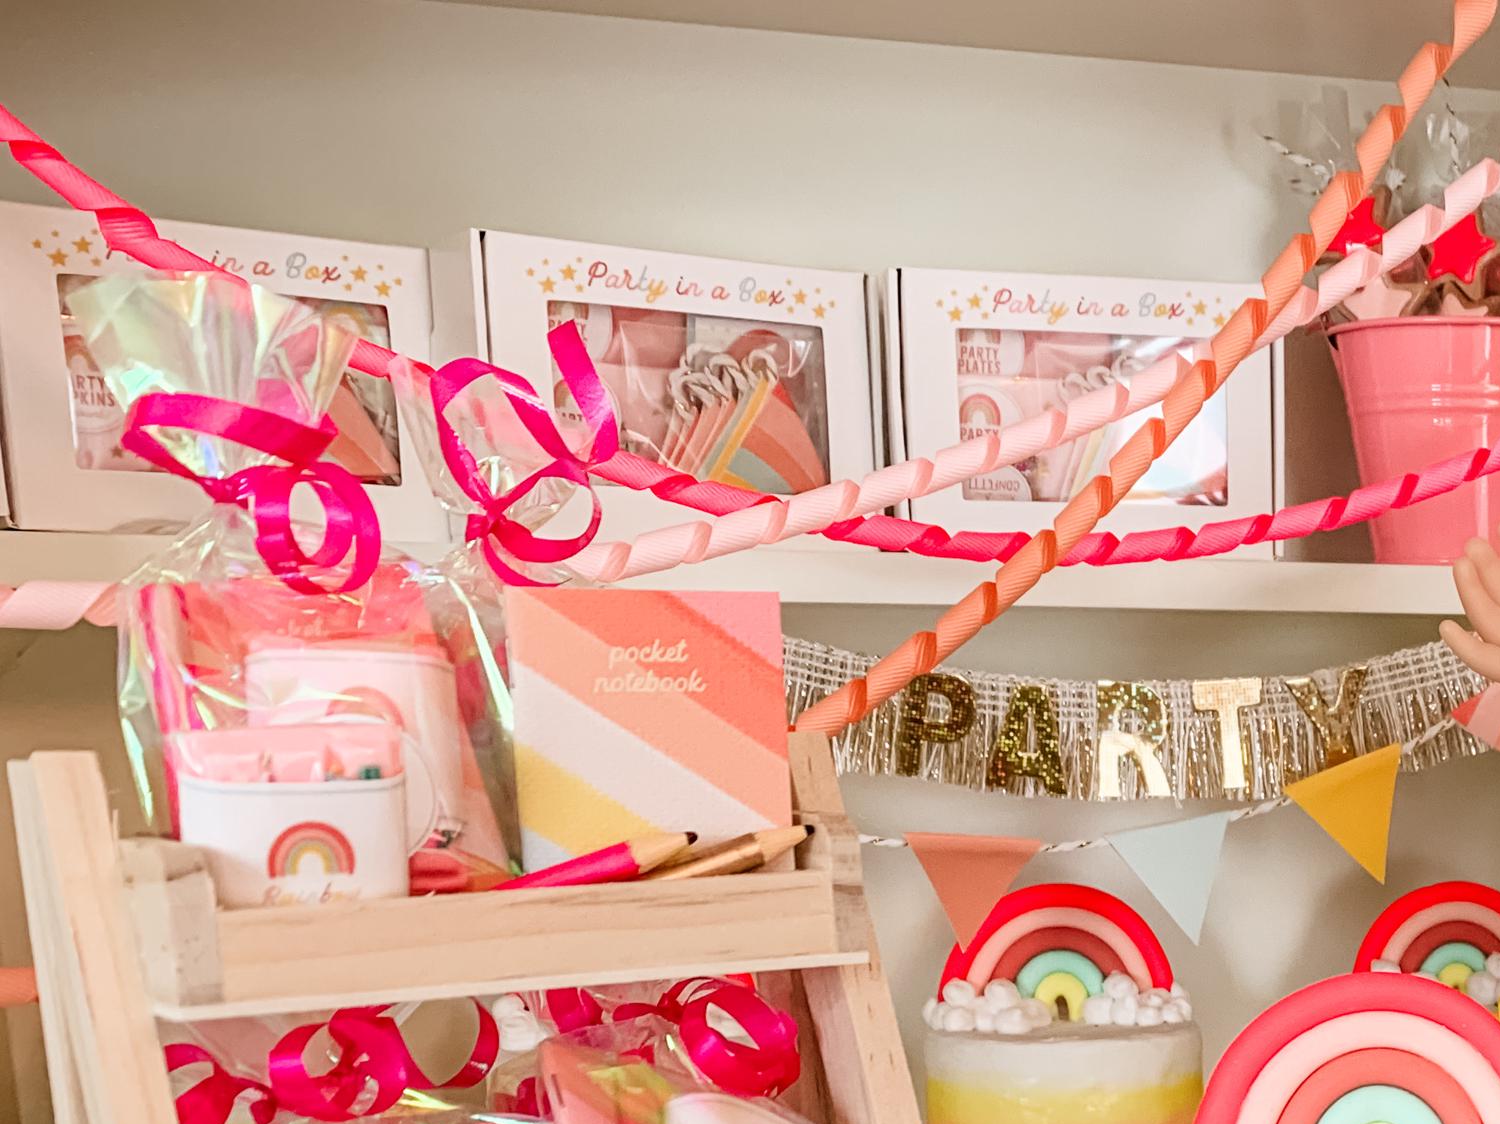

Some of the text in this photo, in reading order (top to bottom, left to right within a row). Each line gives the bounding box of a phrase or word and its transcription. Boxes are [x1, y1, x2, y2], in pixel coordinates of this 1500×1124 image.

[252, 258, 276, 276] a
[286, 251, 341, 283] Box
[588, 261, 785, 307] Party in a Box
[993, 288, 1185, 325] Party in a Box
[958, 359, 1001, 375] PLATES
[960, 345, 1000, 361] PARTY
[74, 391, 115, 407] KINS
[608, 638, 690, 669] pocket
[592, 668, 707, 694] notebook
[895, 665, 1369, 799] PARTY
